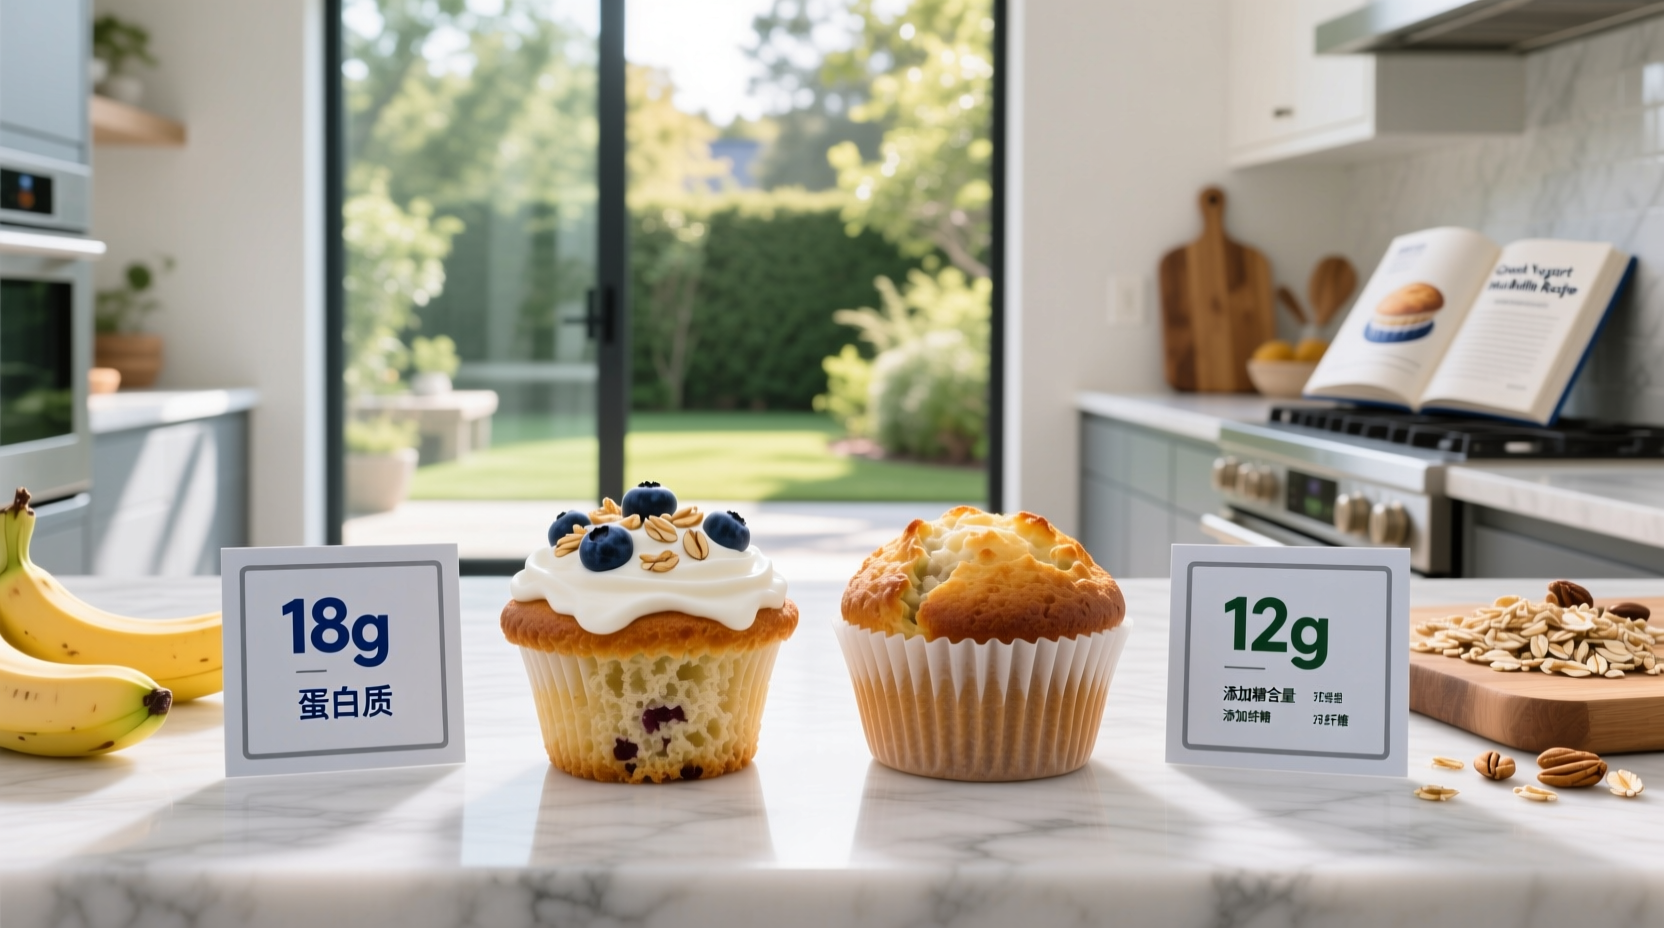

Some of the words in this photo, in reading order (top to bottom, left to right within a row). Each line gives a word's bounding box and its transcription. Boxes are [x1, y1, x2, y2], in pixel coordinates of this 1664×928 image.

[281, 596, 389, 668] 18g
[1224, 596, 1329, 670] 12g
[298, 683, 393, 721] 蛋白质
